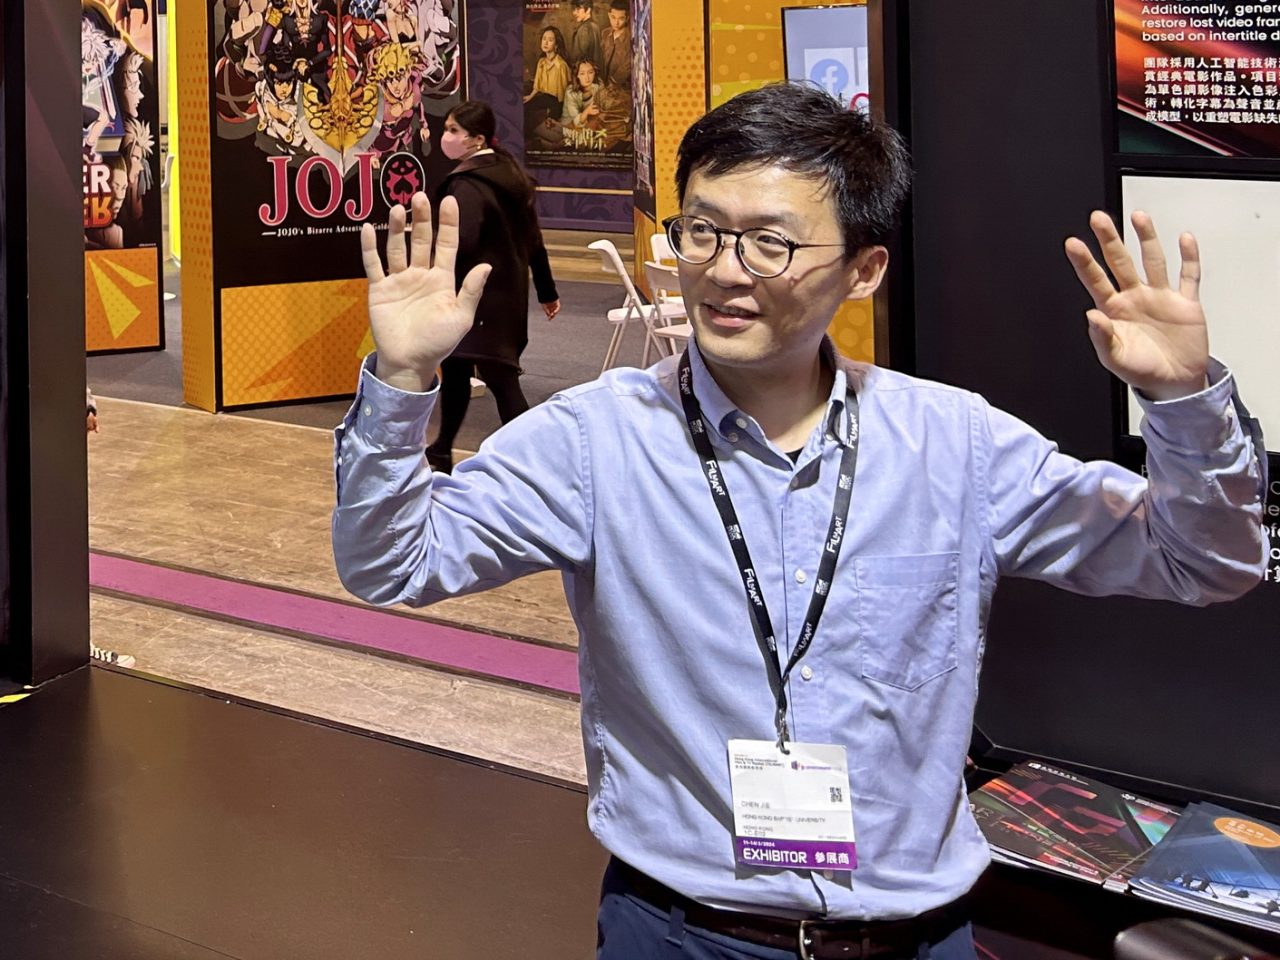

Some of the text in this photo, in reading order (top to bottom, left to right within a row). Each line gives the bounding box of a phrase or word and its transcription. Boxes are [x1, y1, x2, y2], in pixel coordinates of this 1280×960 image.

[1141, 3, 1229, 17] Additionally,
[1142, 18, 1187, 28] restore
[1189, 17, 1214, 28] lost
[1216, 16, 1254, 28] video
[1142, 31, 1185, 41] based
[1188, 32, 1206, 41] on
[1209, 30, 1267, 41] intertitle
[742, 847, 850, 865] EXHIBITOR 參展商
